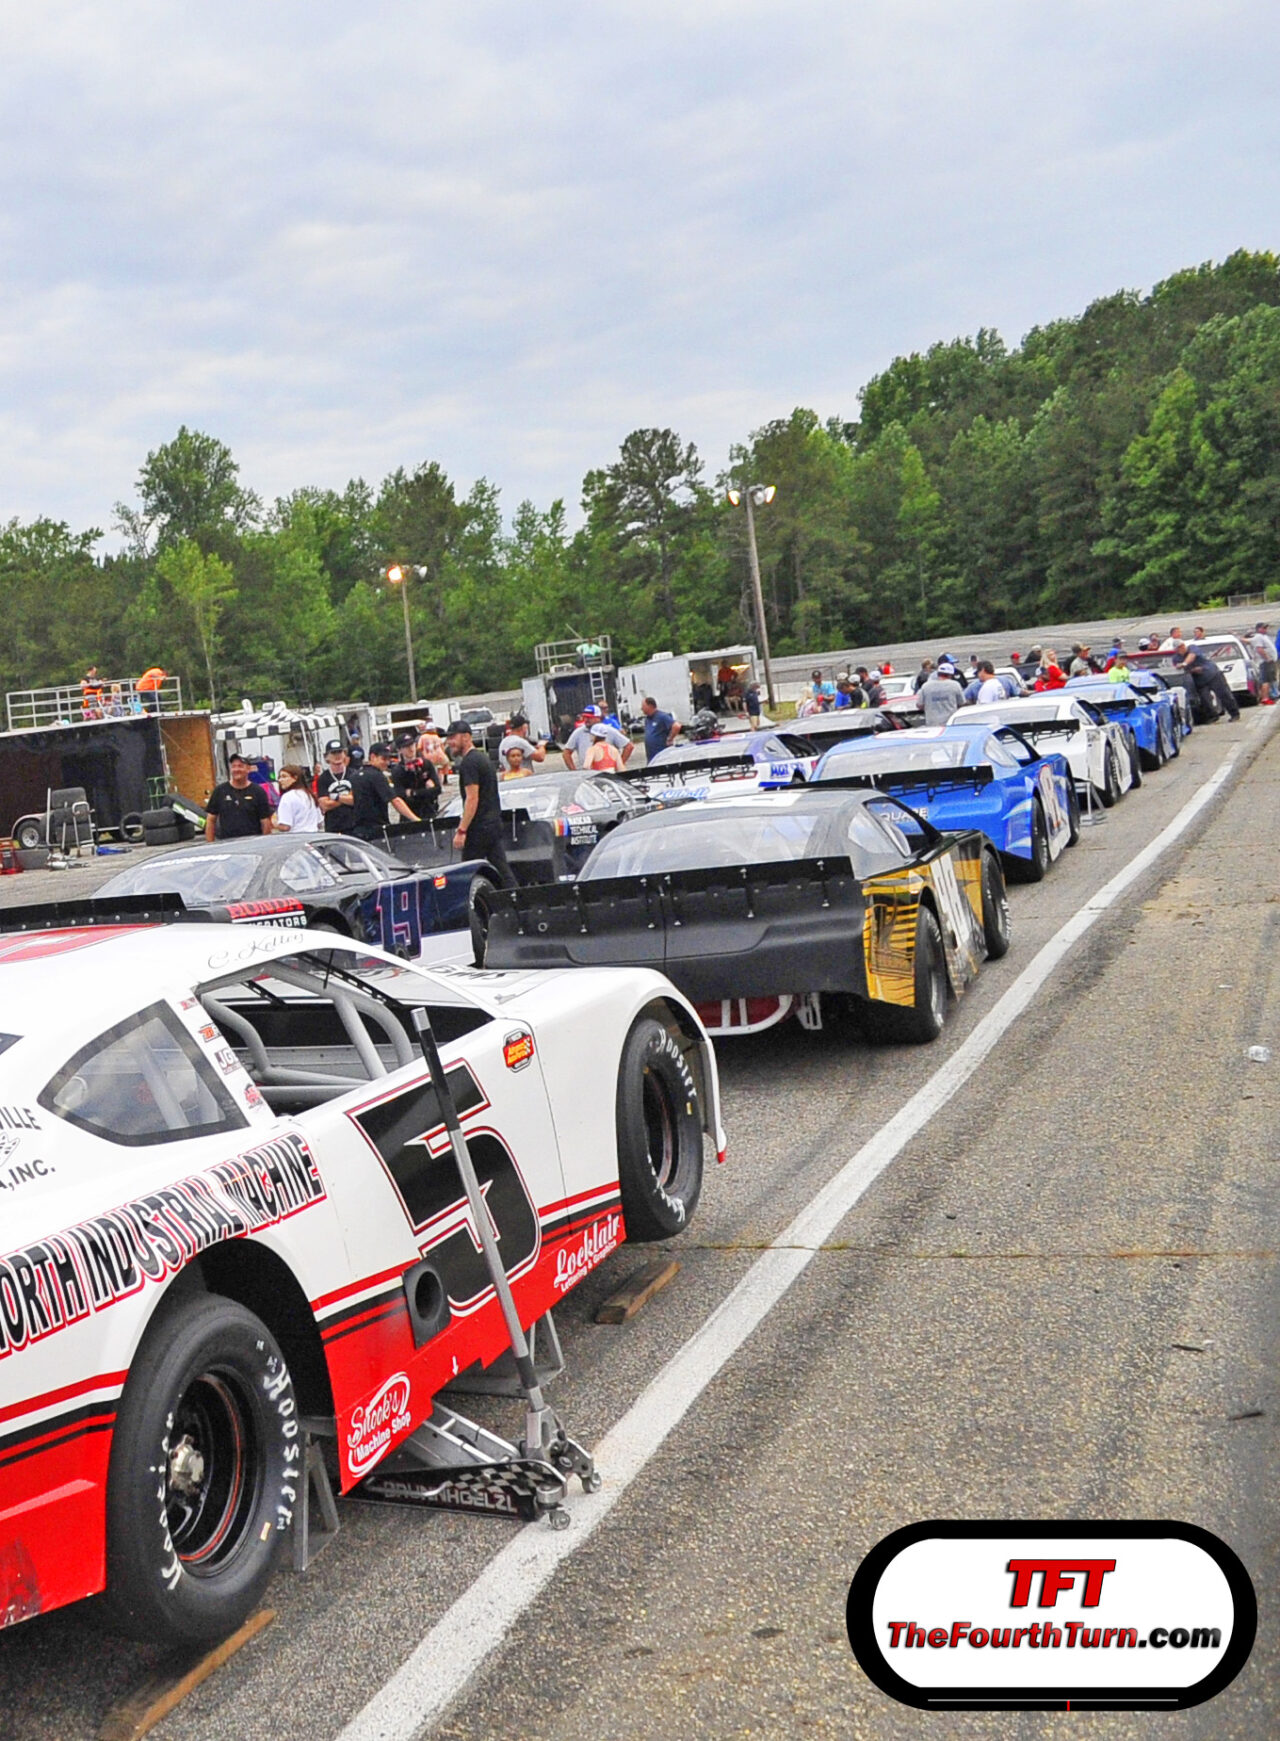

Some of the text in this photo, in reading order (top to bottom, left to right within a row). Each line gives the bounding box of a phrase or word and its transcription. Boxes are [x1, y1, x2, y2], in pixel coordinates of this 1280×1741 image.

[227, 897, 304, 918] HONDA
[63, 1175, 247, 1312] INDUSTRIAL
[205, 1132, 328, 1234] MACHINE
[344, 1057, 542, 1317] 5
[355, 1410, 412, 1463] Machine Shop
